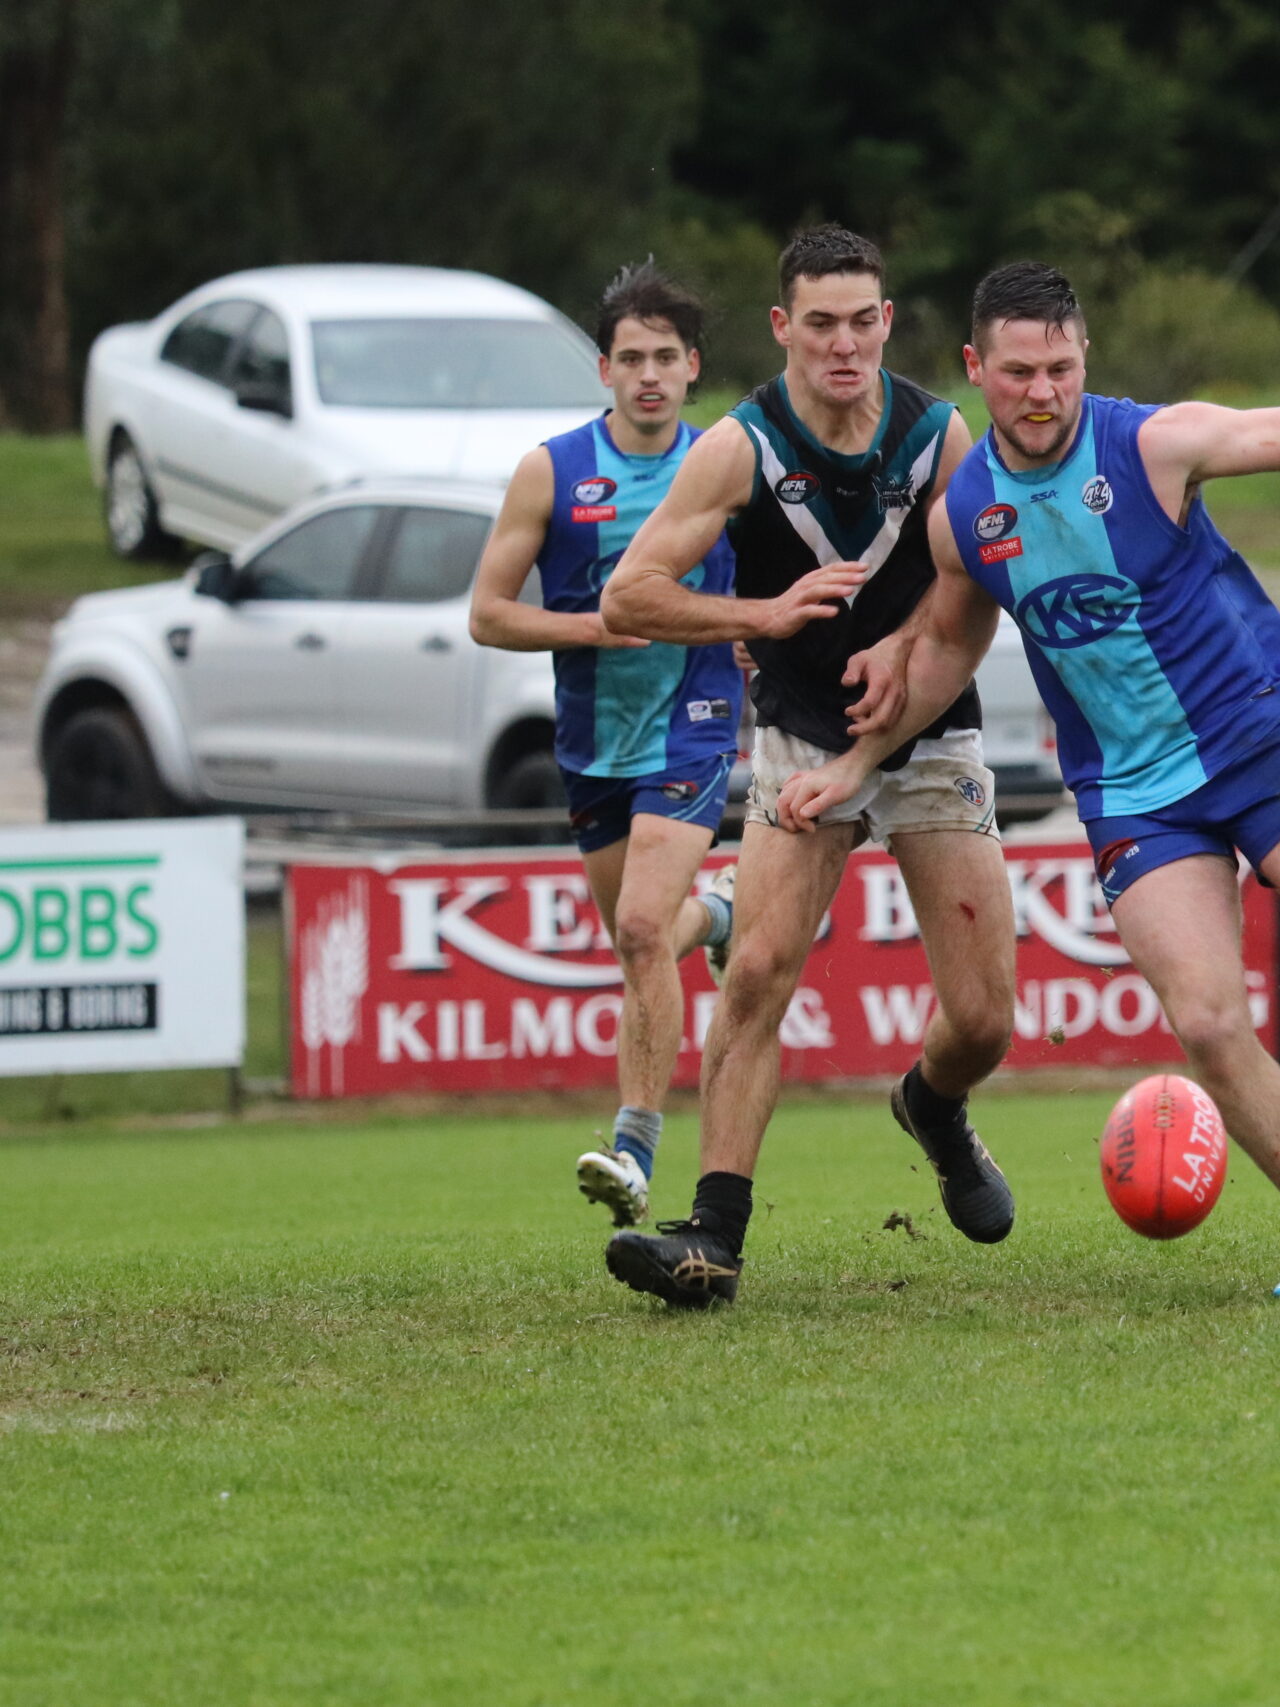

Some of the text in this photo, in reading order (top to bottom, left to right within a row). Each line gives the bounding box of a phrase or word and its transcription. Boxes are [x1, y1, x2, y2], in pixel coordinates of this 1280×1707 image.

[780, 480, 807, 492] NFNL
[977, 511, 1006, 531] NFNL
[982, 541, 1018, 556] LA TROBE
[1172, 1152, 1206, 1193] LA
